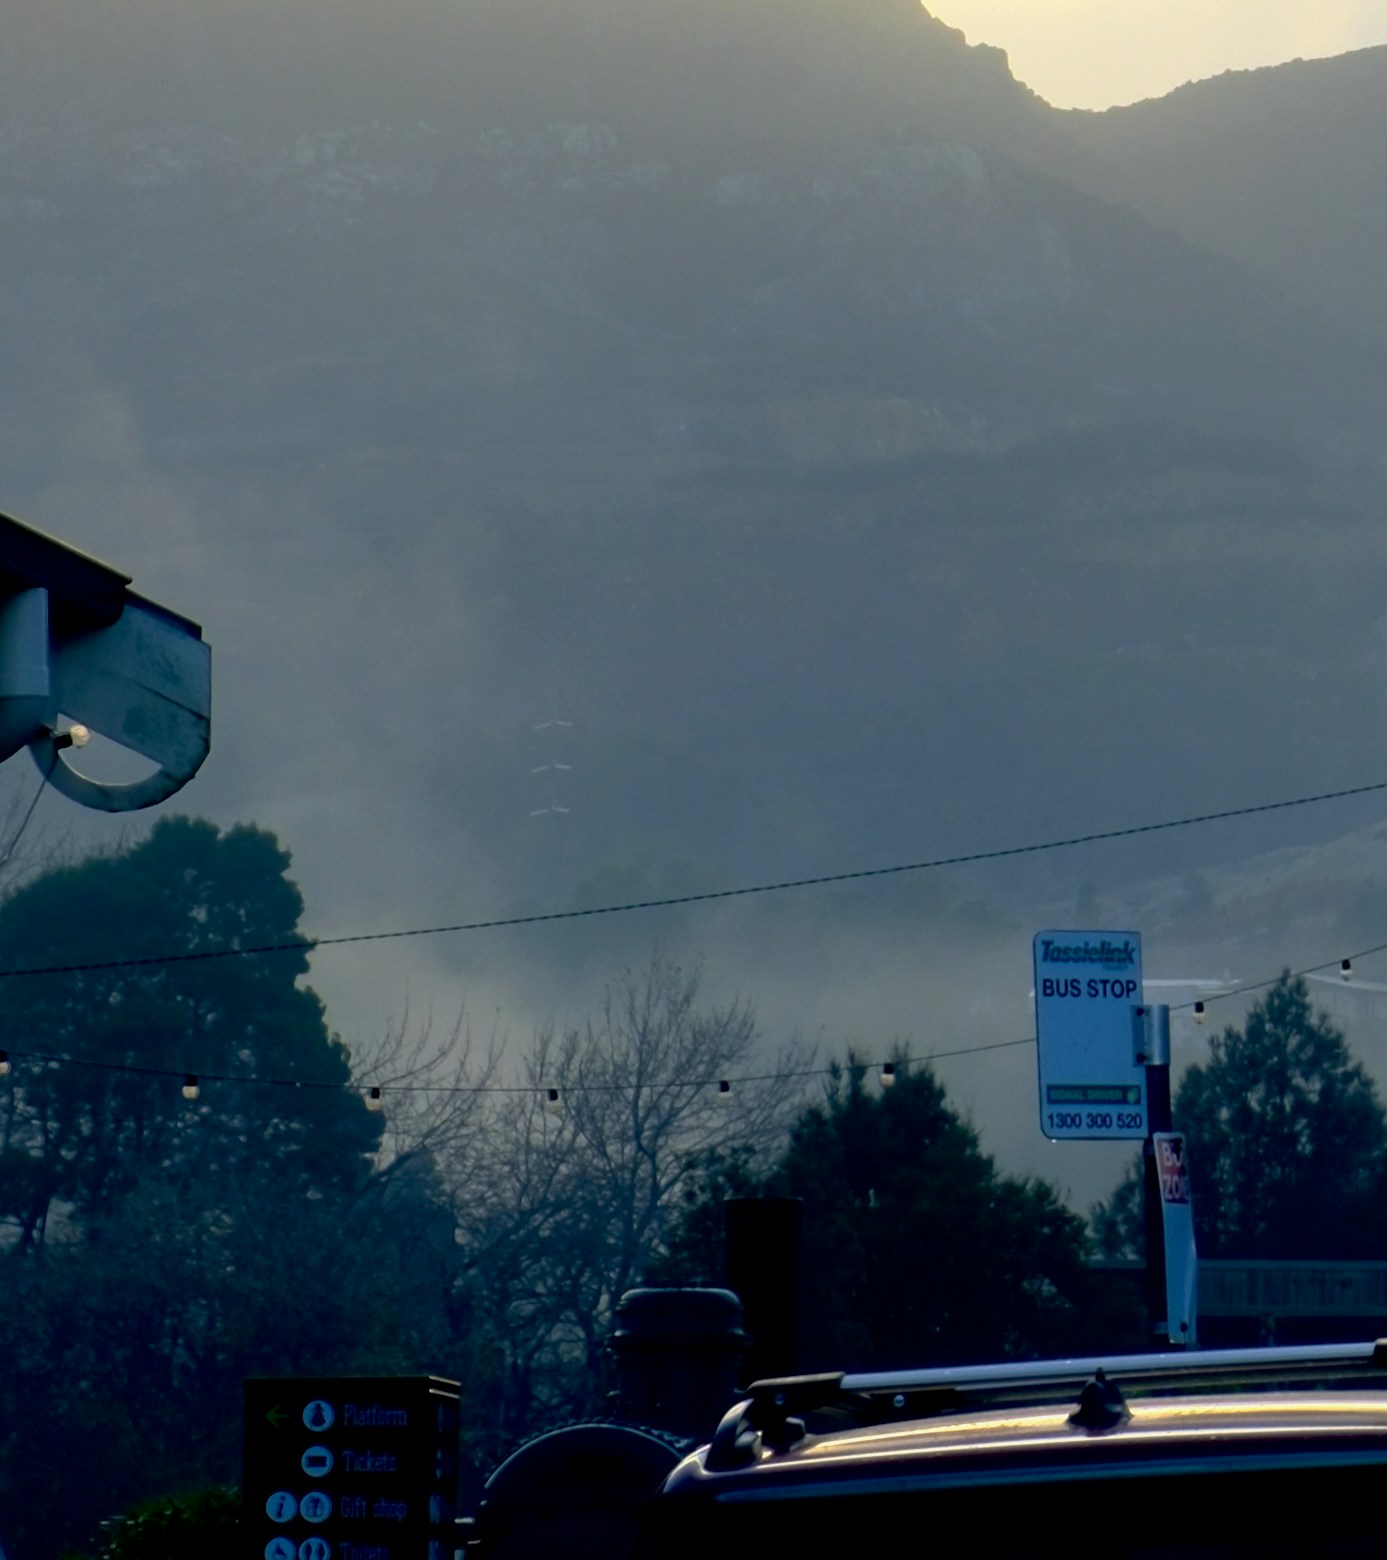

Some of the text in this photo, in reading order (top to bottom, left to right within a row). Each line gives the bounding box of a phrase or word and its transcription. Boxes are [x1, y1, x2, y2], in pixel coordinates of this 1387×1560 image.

[1041, 940, 1136, 965] Tassielink
[1043, 979, 1137, 999] BUS STOP
[1048, 1112, 1143, 1129] 1300 300 520
[342, 1405, 408, 1427] Platform
[341, 1451, 397, 1473] Tickets
[340, 1495, 408, 1523] Gift shop
